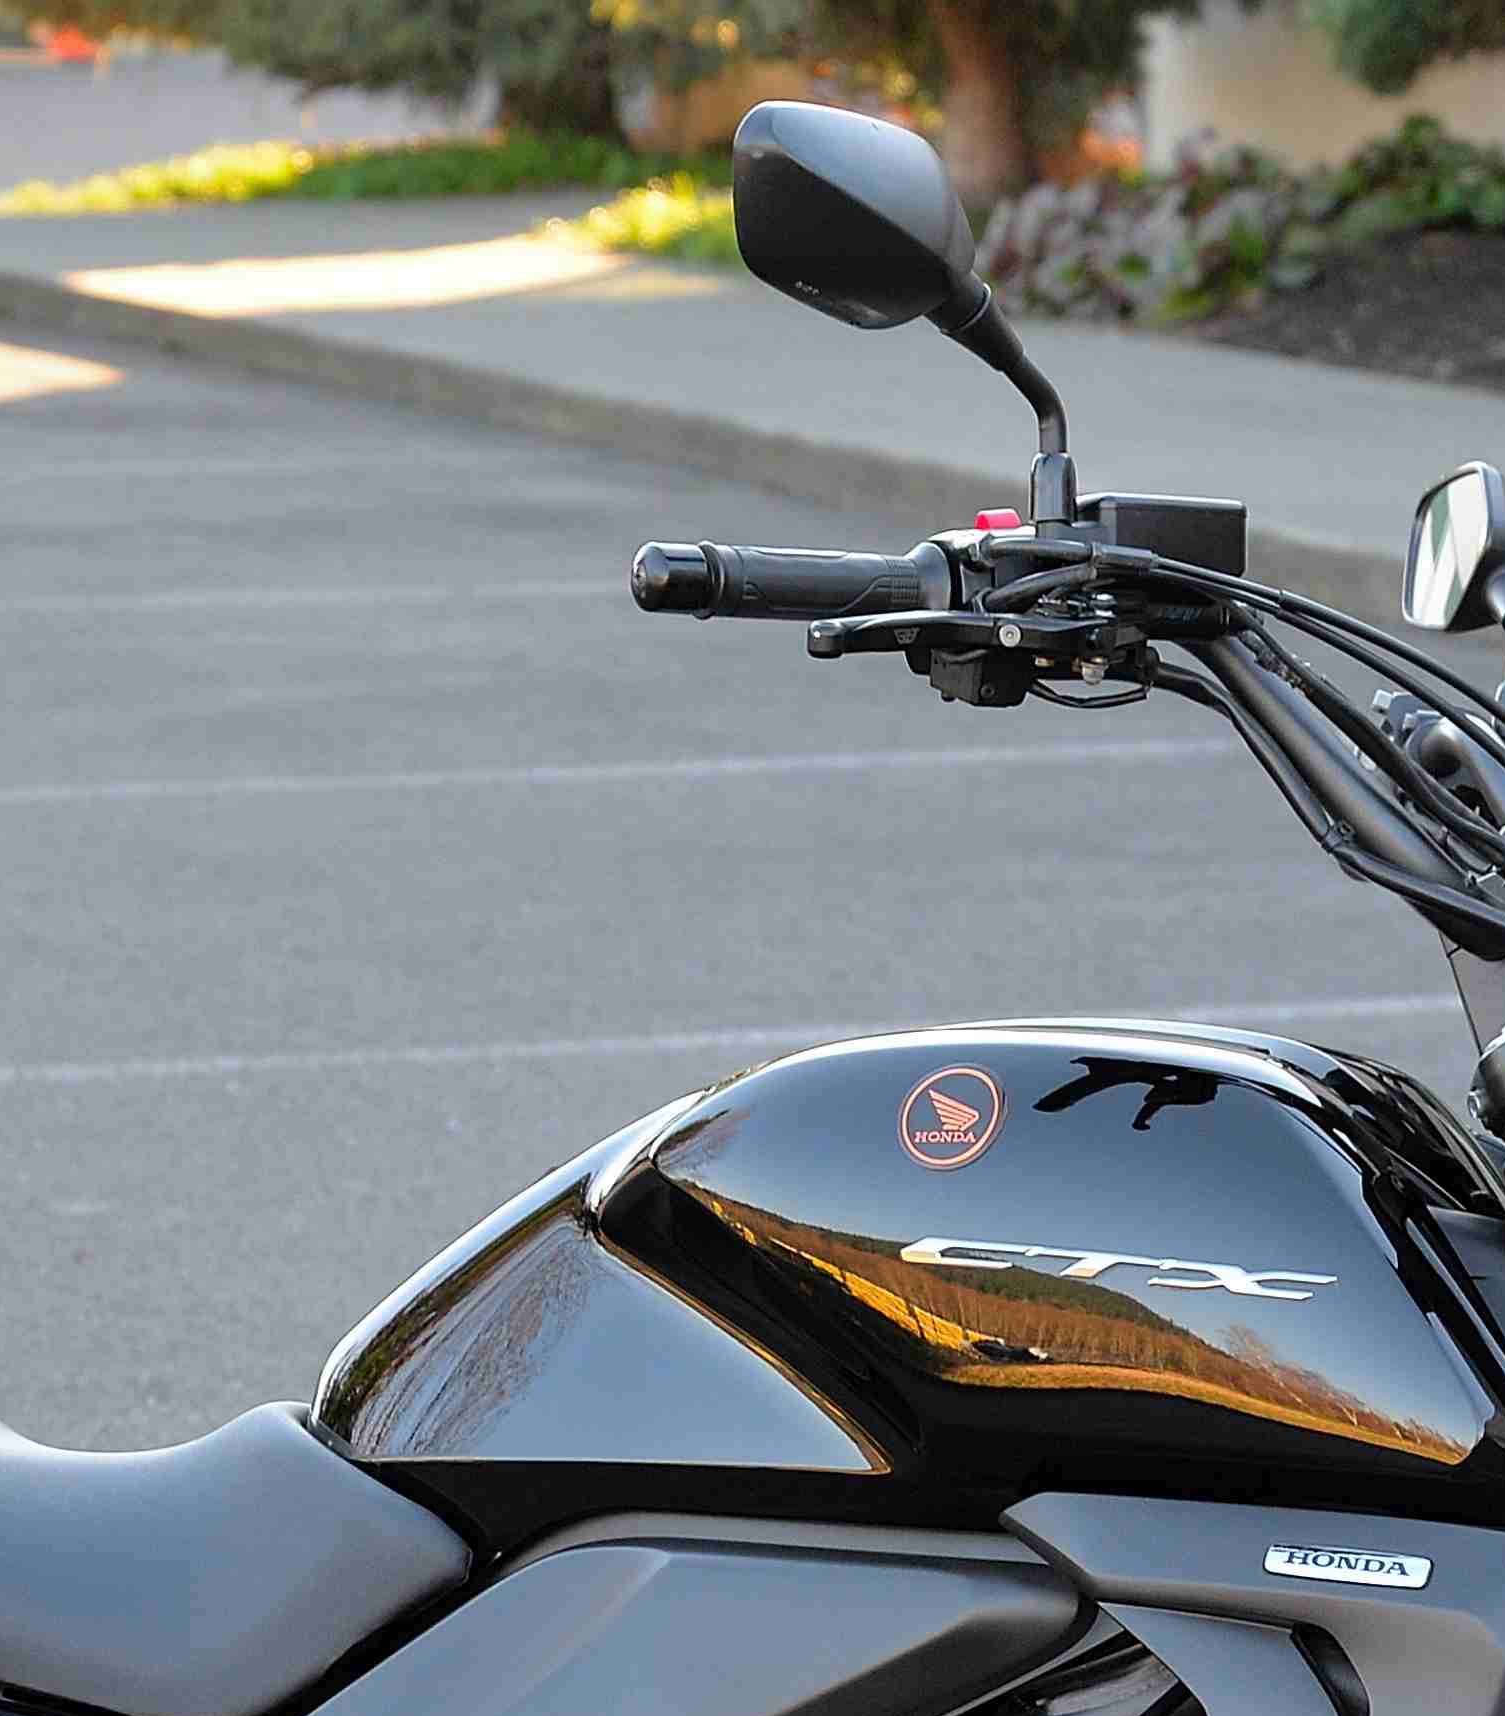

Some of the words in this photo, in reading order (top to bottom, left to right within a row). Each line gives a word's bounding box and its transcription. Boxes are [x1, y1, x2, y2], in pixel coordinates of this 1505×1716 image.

[914, 1130, 978, 1144] HONDA
[900, 1236, 1338, 1301] CTX
[1283, 1550, 1411, 1577] HONDA
